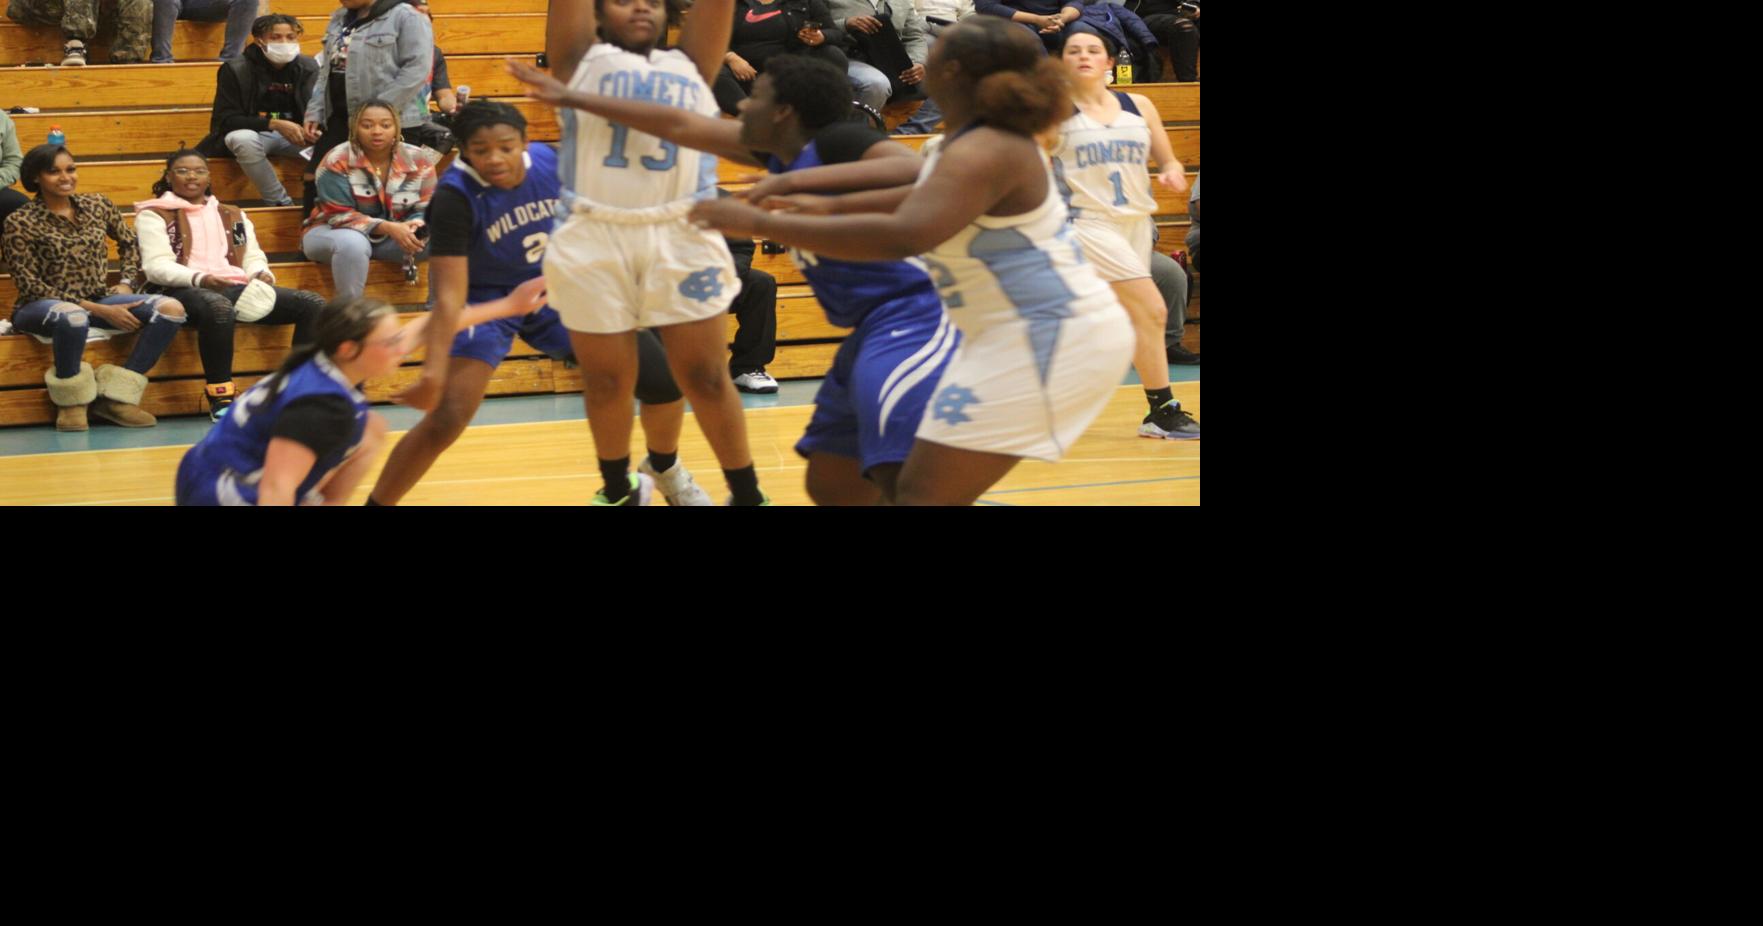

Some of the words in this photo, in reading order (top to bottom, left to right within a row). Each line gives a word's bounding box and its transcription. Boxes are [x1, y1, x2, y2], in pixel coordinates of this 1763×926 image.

[599, 70, 700, 112] COMETS
[1075, 140, 1145, 168] COMETS
[1108, 171, 1128, 206] 1
[486, 199, 560, 243] WILDCAT
